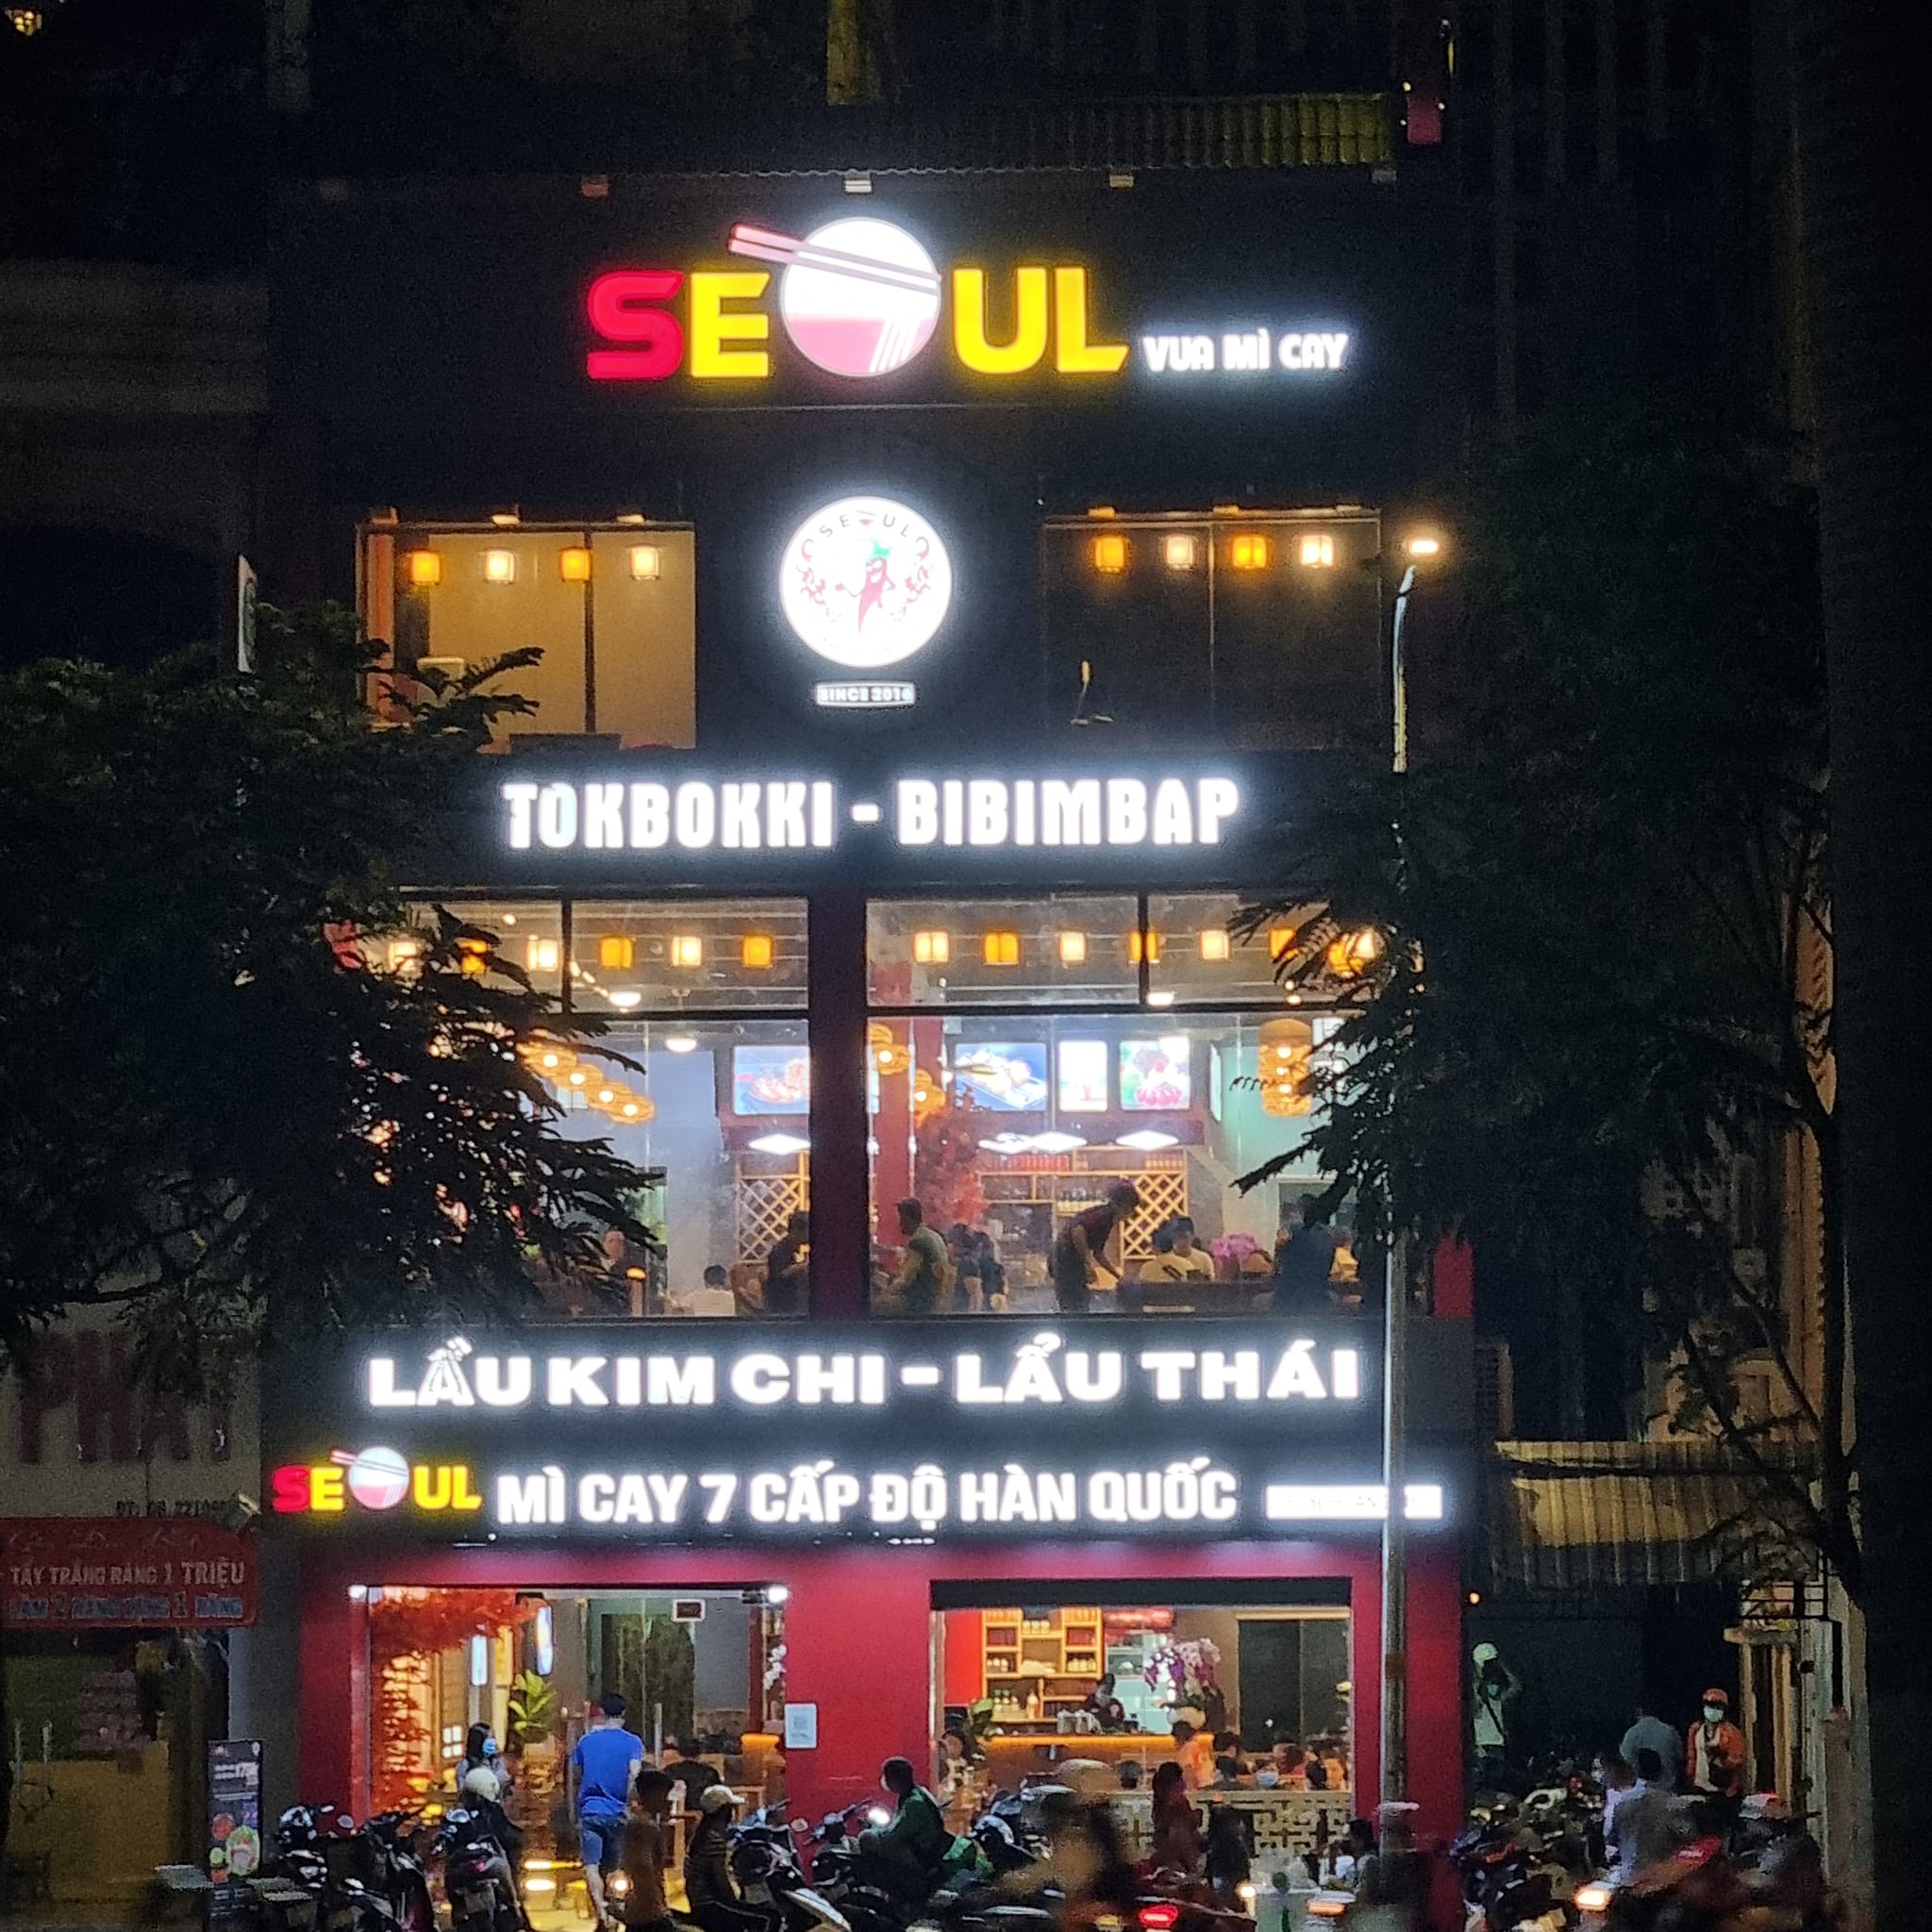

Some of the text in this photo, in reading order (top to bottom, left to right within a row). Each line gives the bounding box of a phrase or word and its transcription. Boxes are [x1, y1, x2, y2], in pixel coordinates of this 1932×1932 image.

[1142, 327, 1349, 372] VUA MÌ CAY
[818, 687, 869, 703] SINCE
[503, 781, 833, 849] TOKBOKKI
[898, 777, 1240, 846] BIBIMBAP
[548, 1356, 715, 1406] KIM
[730, 1353, 885, 1405] CHI
[957, 1332, 1122, 1403] LẨU
[1141, 1339, 1358, 1400] THÁI
[497, 1466, 565, 1524] MÌ
[578, 1474, 688, 1524] CAY
[699, 1474, 738, 1523] 7
[749, 1459, 860, 1523] CẤP
[868, 1464, 947, 1531] ĐỘ
[959, 1463, 1076, 1522] HÀN
[1088, 1457, 1237, 1523] QUỐC
